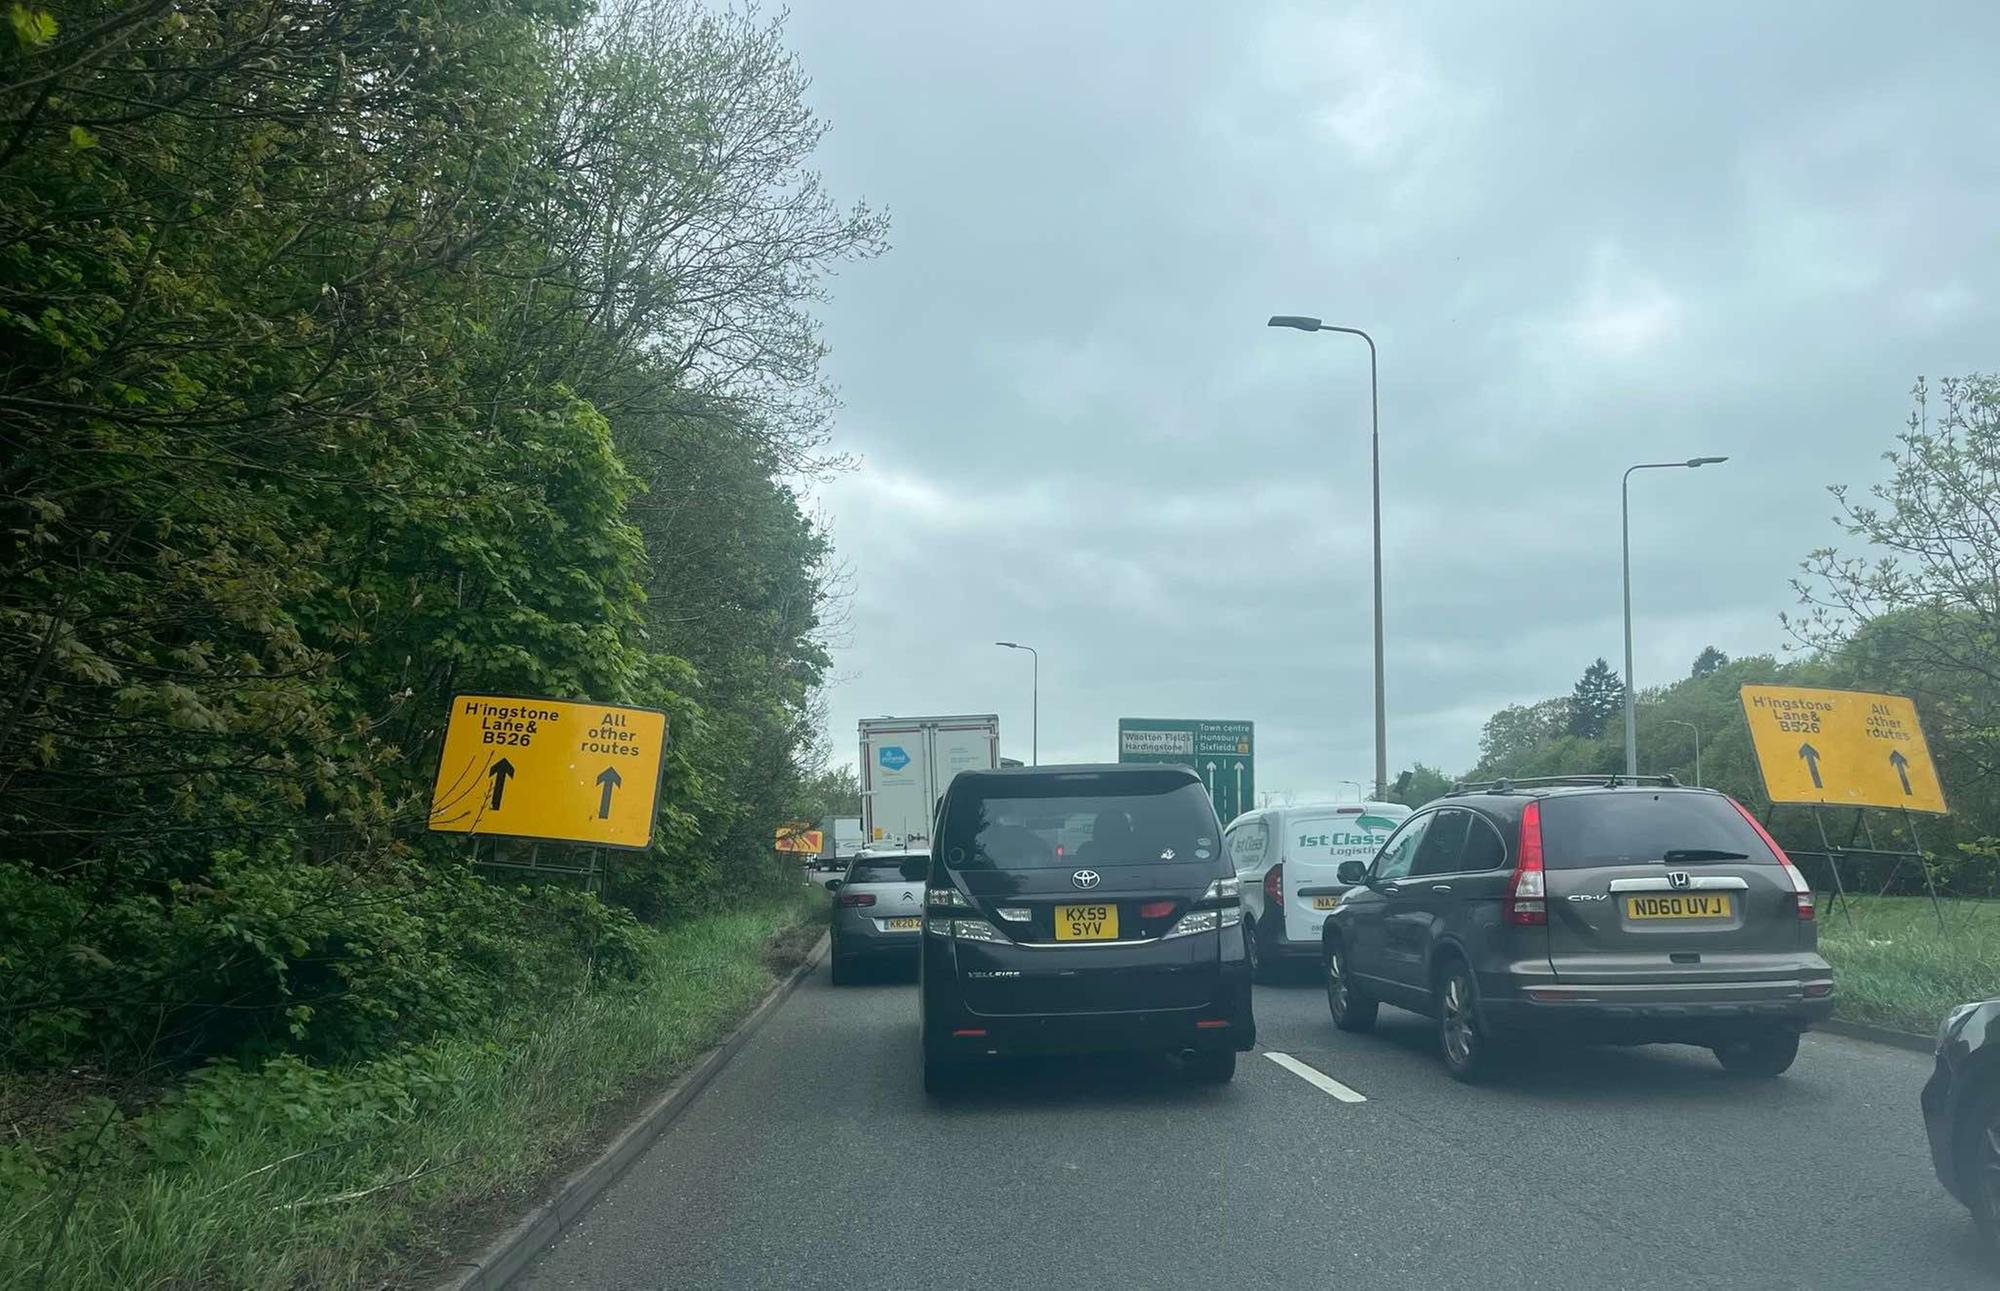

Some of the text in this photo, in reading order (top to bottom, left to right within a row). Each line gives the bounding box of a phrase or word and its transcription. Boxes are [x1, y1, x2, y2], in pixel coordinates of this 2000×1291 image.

[1872, 703, 1890, 715] All
[601, 713, 626, 727] All
[1779, 721, 1820, 733] B526
[1866, 716, 1901, 728] other
[483, 731, 531, 746] B526
[588, 727, 636, 742] other
[1866, 729, 1911, 740] routes
[581, 742, 640, 756] routes
[1299, 832, 1387, 847] 1st Class
[1317, 898, 1338, 907] NA2
[1635, 898, 1721, 915] ND60 UVJ
[1066, 907, 1107, 921] KX59
[1072, 922, 1102, 936] SYV
